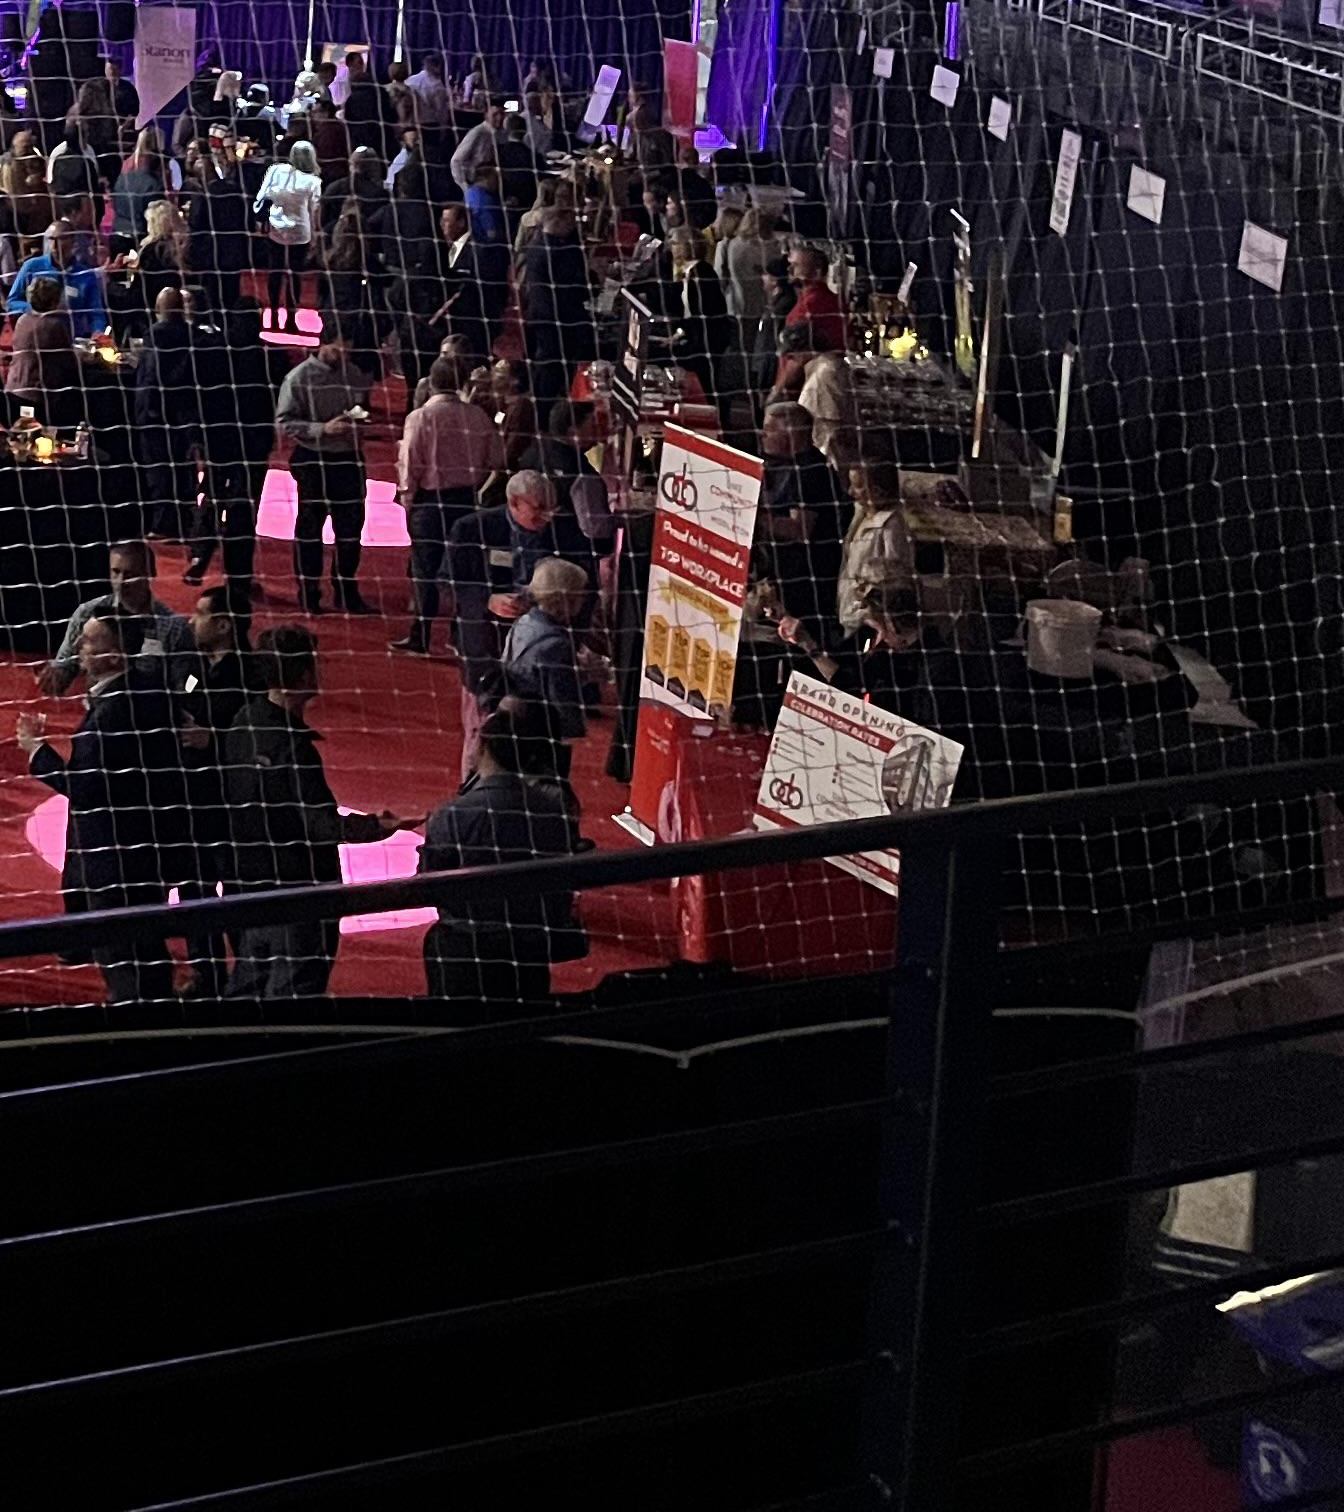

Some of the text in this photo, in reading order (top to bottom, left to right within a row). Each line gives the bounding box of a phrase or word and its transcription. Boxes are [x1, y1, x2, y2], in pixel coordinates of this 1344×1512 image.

[660, 545, 681, 564] TOP
[791, 679, 906, 737] GRAND OPENING
